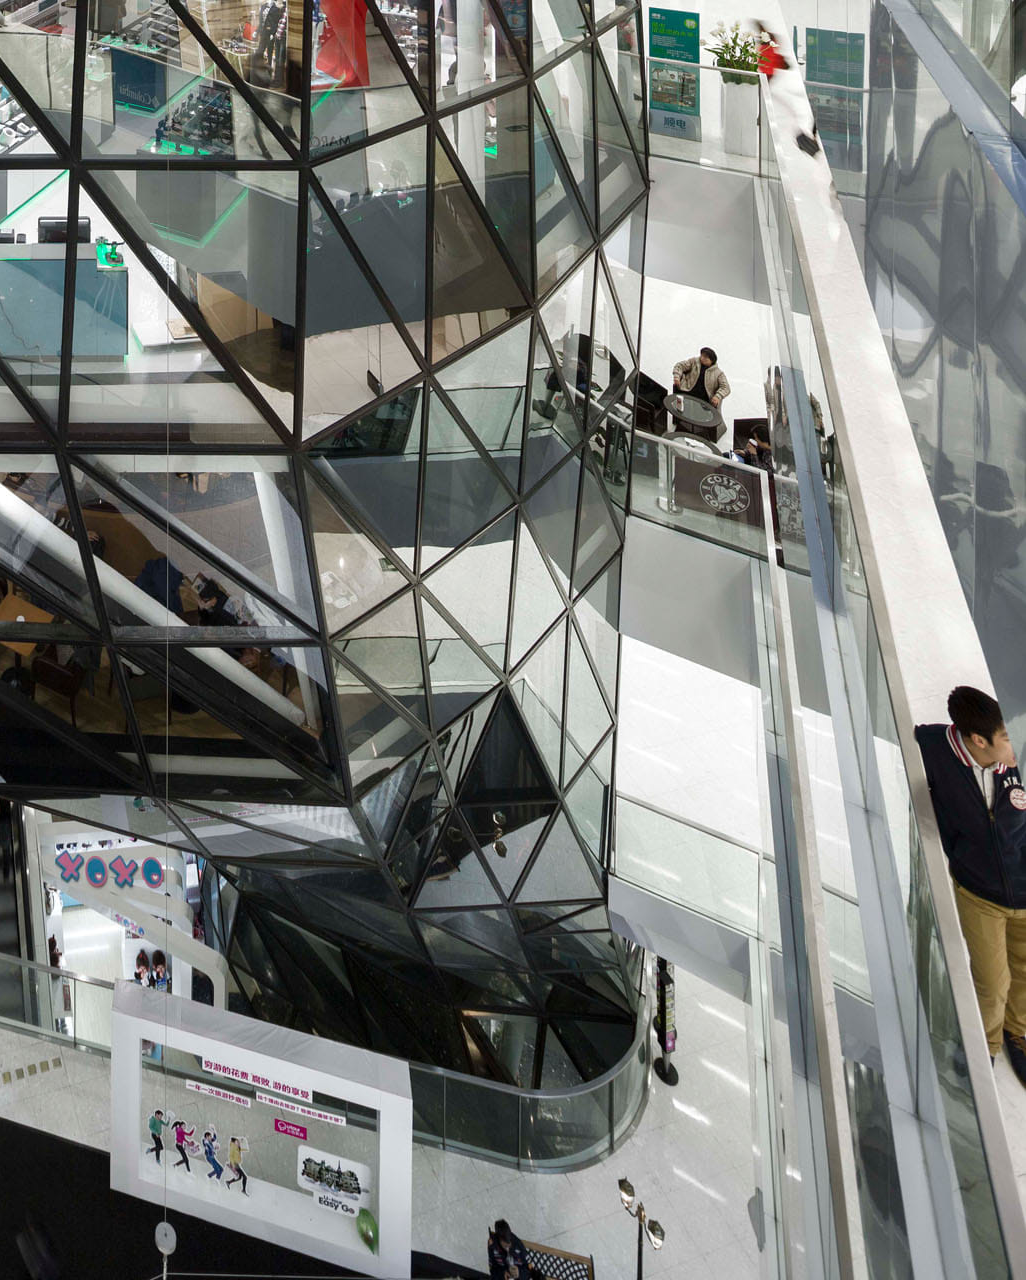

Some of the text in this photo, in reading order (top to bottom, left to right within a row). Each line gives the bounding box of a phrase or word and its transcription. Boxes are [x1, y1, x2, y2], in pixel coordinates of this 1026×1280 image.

[706, 475, 742, 492] COSTA
[55, 849, 164, 888] XOXO
[318, 1196, 355, 1214] Easy Go
